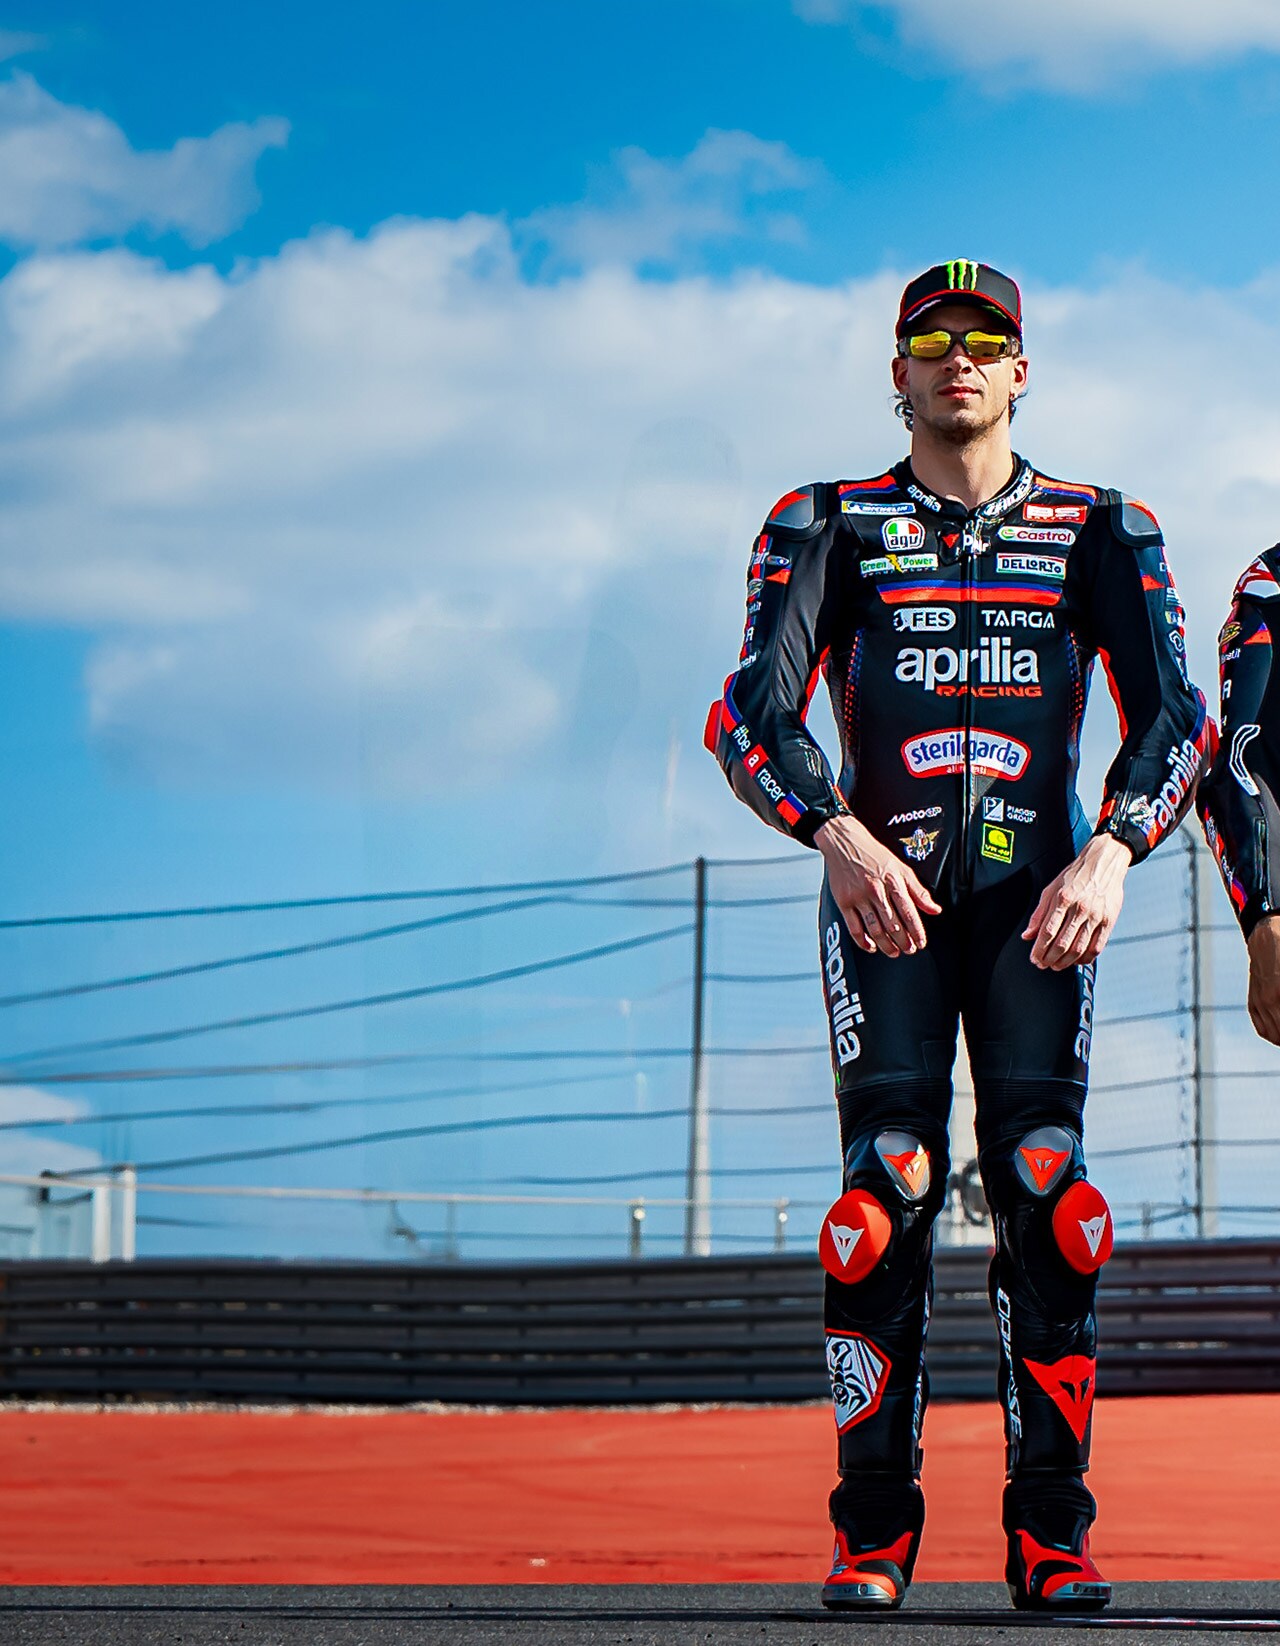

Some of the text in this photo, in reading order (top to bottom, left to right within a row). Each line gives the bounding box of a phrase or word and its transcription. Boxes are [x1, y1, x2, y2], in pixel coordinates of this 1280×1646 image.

[1017, 531, 1073, 544] Castrol
[903, 556, 934, 567] Power
[981, 610, 1055, 628] TARGA
[895, 637, 1040, 690] aprilia
[936, 685, 1043, 697] RACING
[732, 725, 786, 801] #be a racer
[911, 734, 1020, 768] sterilgarda
[1150, 739, 1202, 829] aprilia
[825, 921, 865, 1067] aprilia
